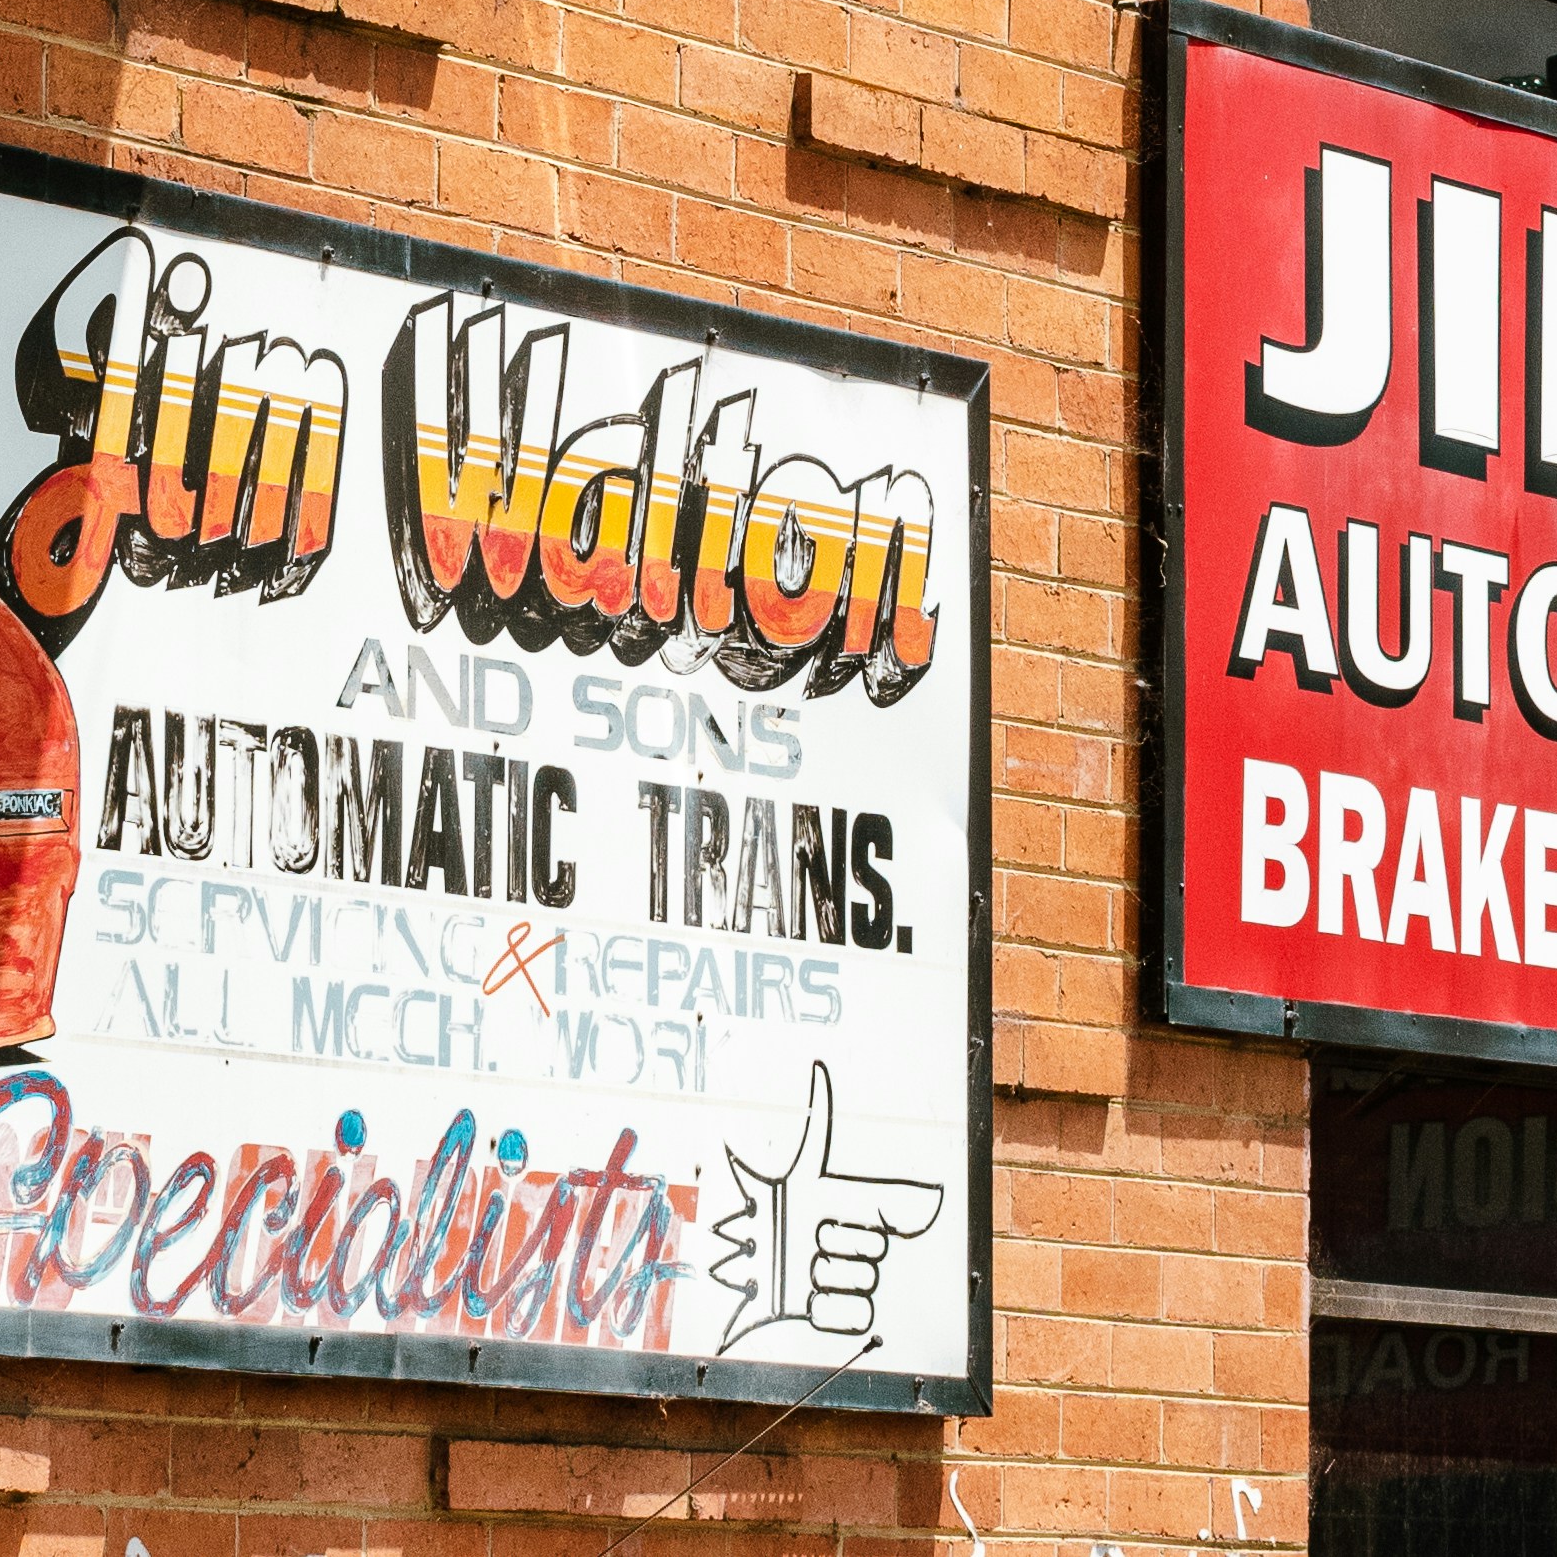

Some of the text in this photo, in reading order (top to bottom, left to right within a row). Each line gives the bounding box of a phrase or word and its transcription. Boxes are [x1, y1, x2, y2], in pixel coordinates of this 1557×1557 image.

[383, 290, 940, 705] Walton
[335, 637, 803, 780] AND SONS
[95, 703, 914, 953] AUTOMATIC TRANS.
[482, 920, 566, 1017] &
[554, 926, 844, 1026] REPAIRS
